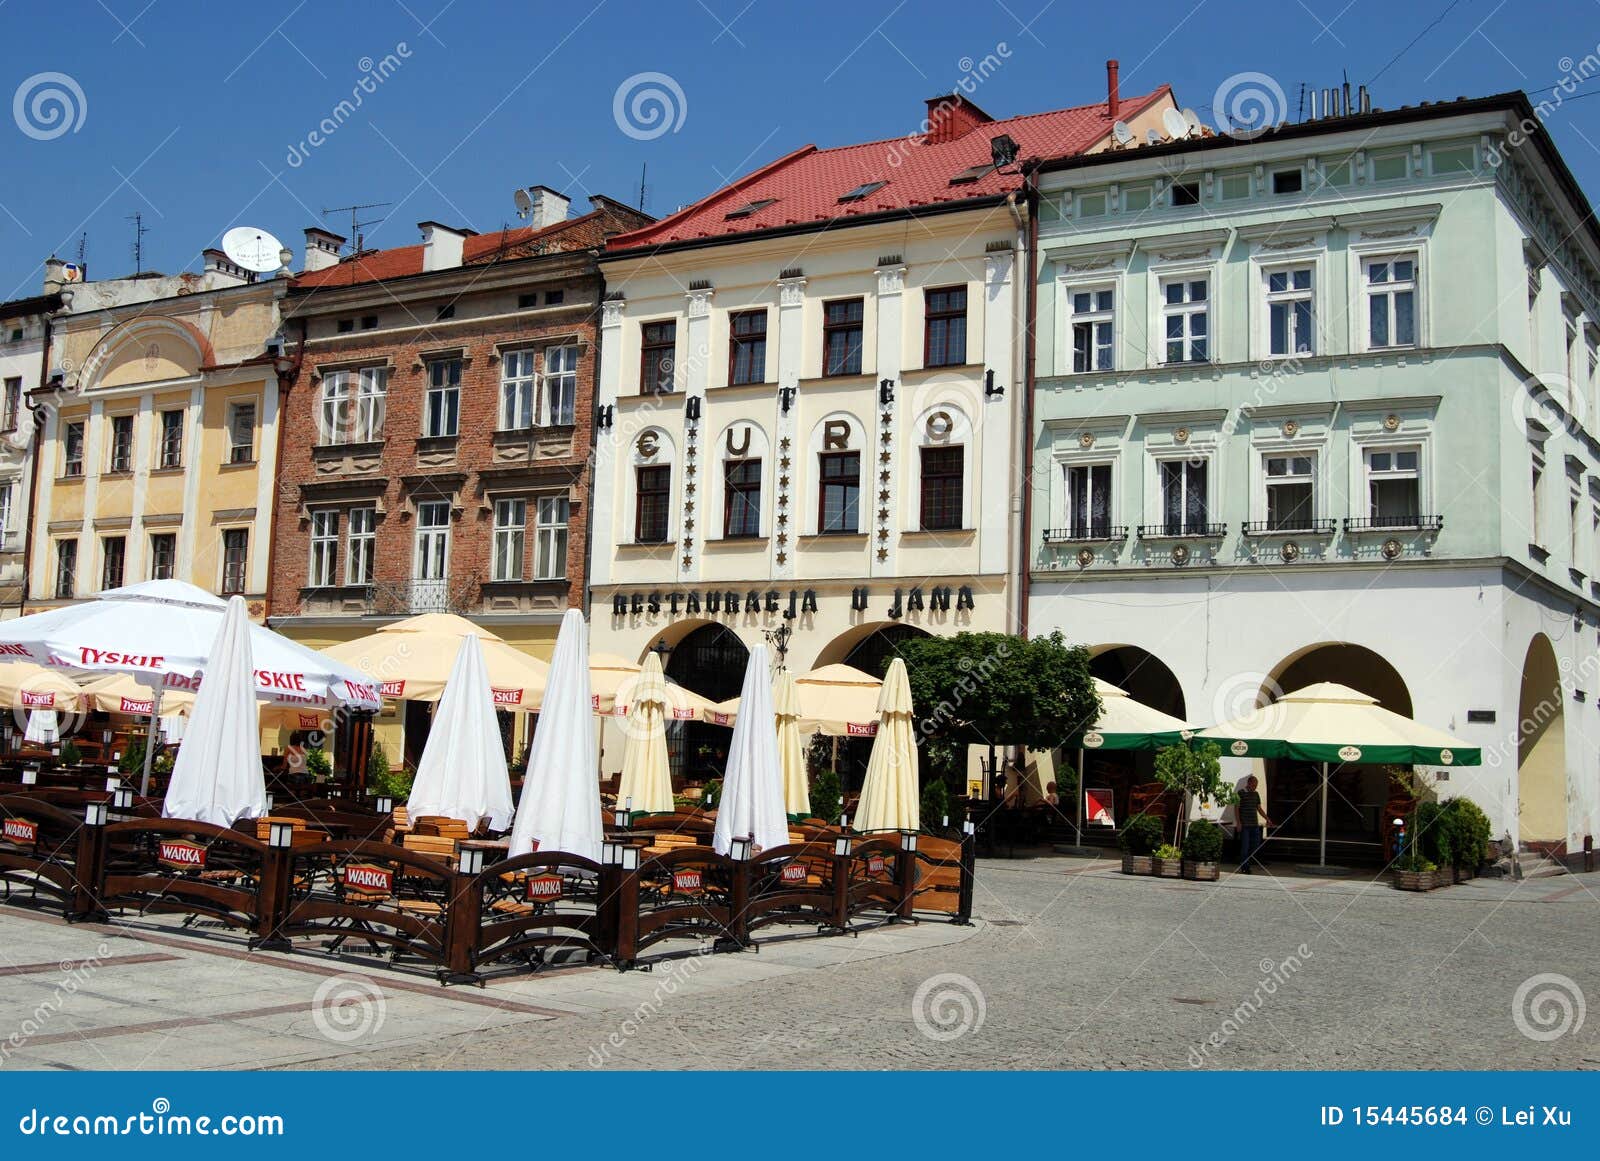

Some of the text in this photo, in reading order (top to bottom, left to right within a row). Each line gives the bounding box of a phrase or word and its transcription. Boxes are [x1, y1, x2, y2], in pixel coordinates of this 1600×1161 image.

[613, 588, 818, 621] RESTAURACJA
[888, 585, 975, 620] JANA
[79, 647, 165, 668] TYSKIE
[23, 693, 53, 705] TYSKIE
[122, 700, 153, 713] TYSKIE
[849, 724, 876, 735] TYSKIE
[4, 824, 34, 840] WARKA
[162, 845, 201, 863] WARKA
[347, 869, 388, 889] WARKA
[676, 874, 700, 888] WARKA
[531, 880, 562, 895] WARKA
